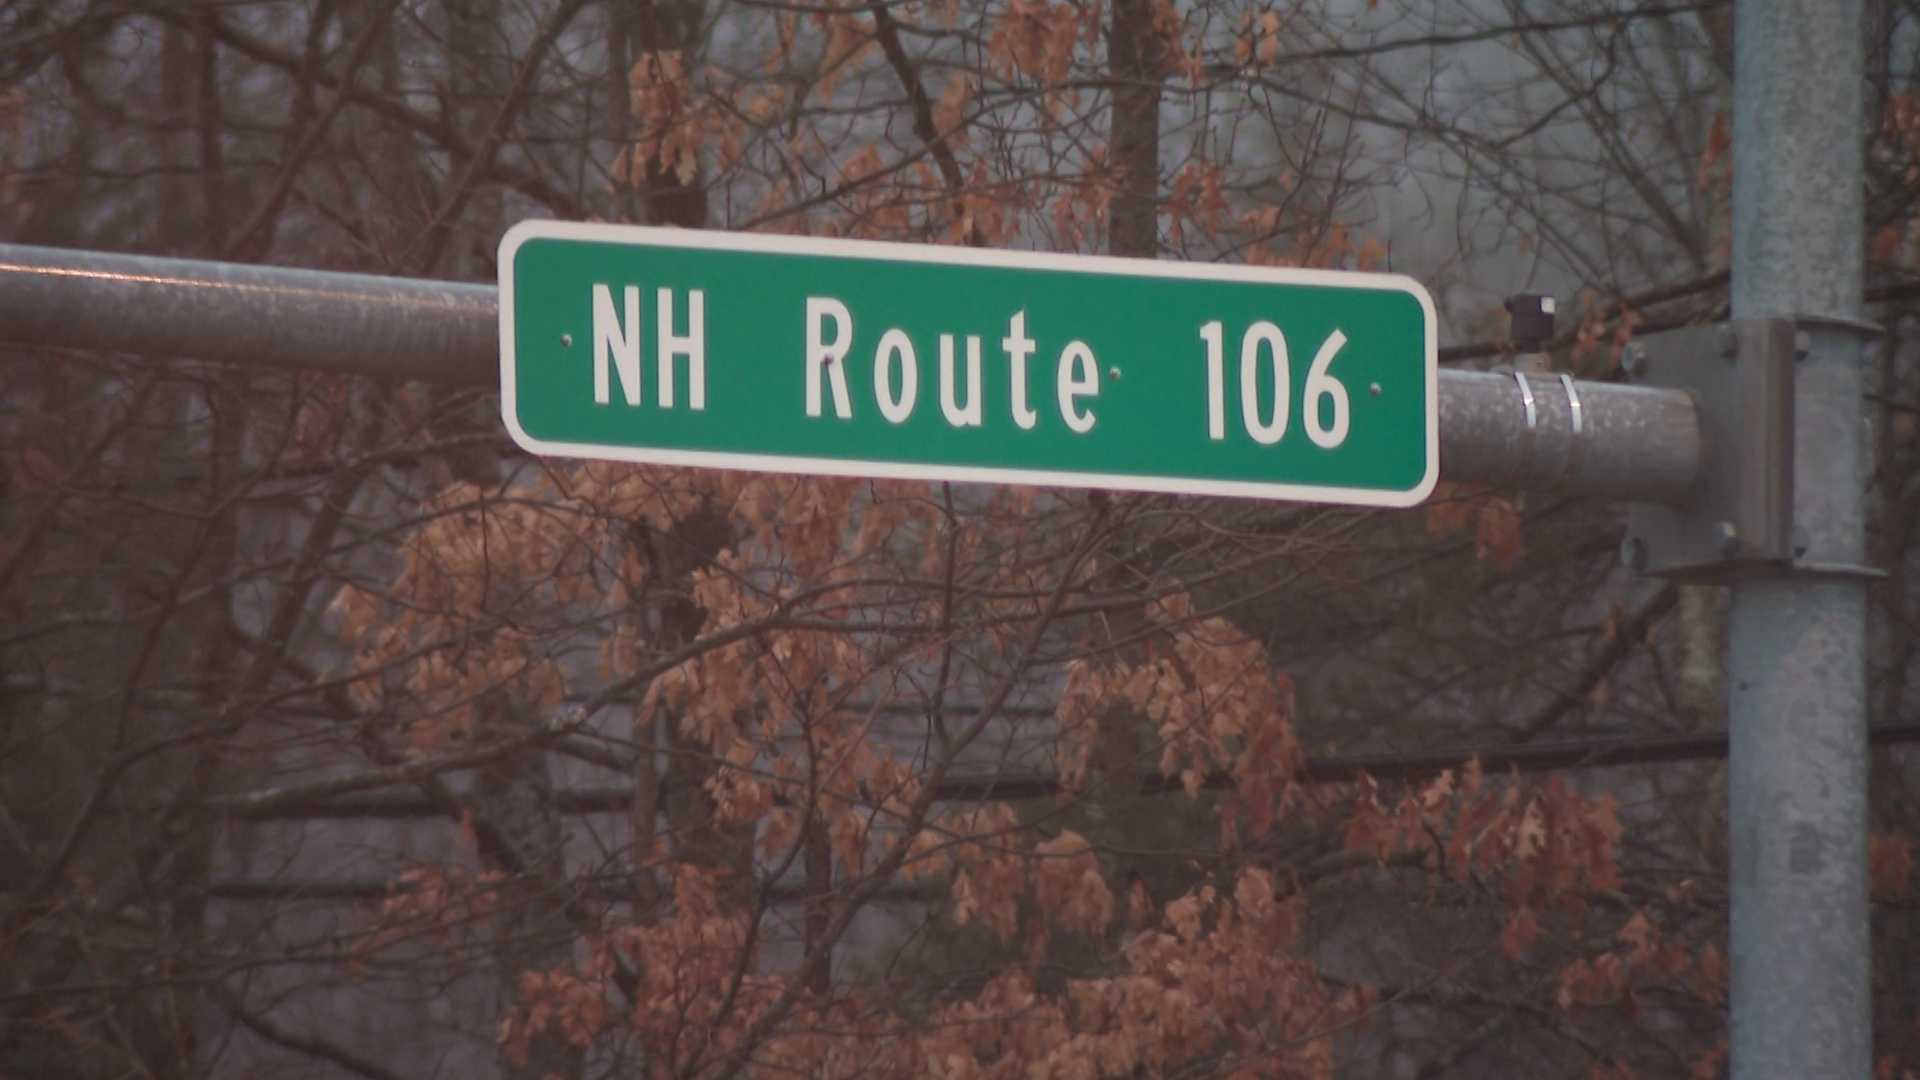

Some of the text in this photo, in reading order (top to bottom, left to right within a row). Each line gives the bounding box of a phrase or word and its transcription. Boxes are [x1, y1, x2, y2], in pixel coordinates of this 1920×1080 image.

[592, 283, 1350, 449] NH Route 106
